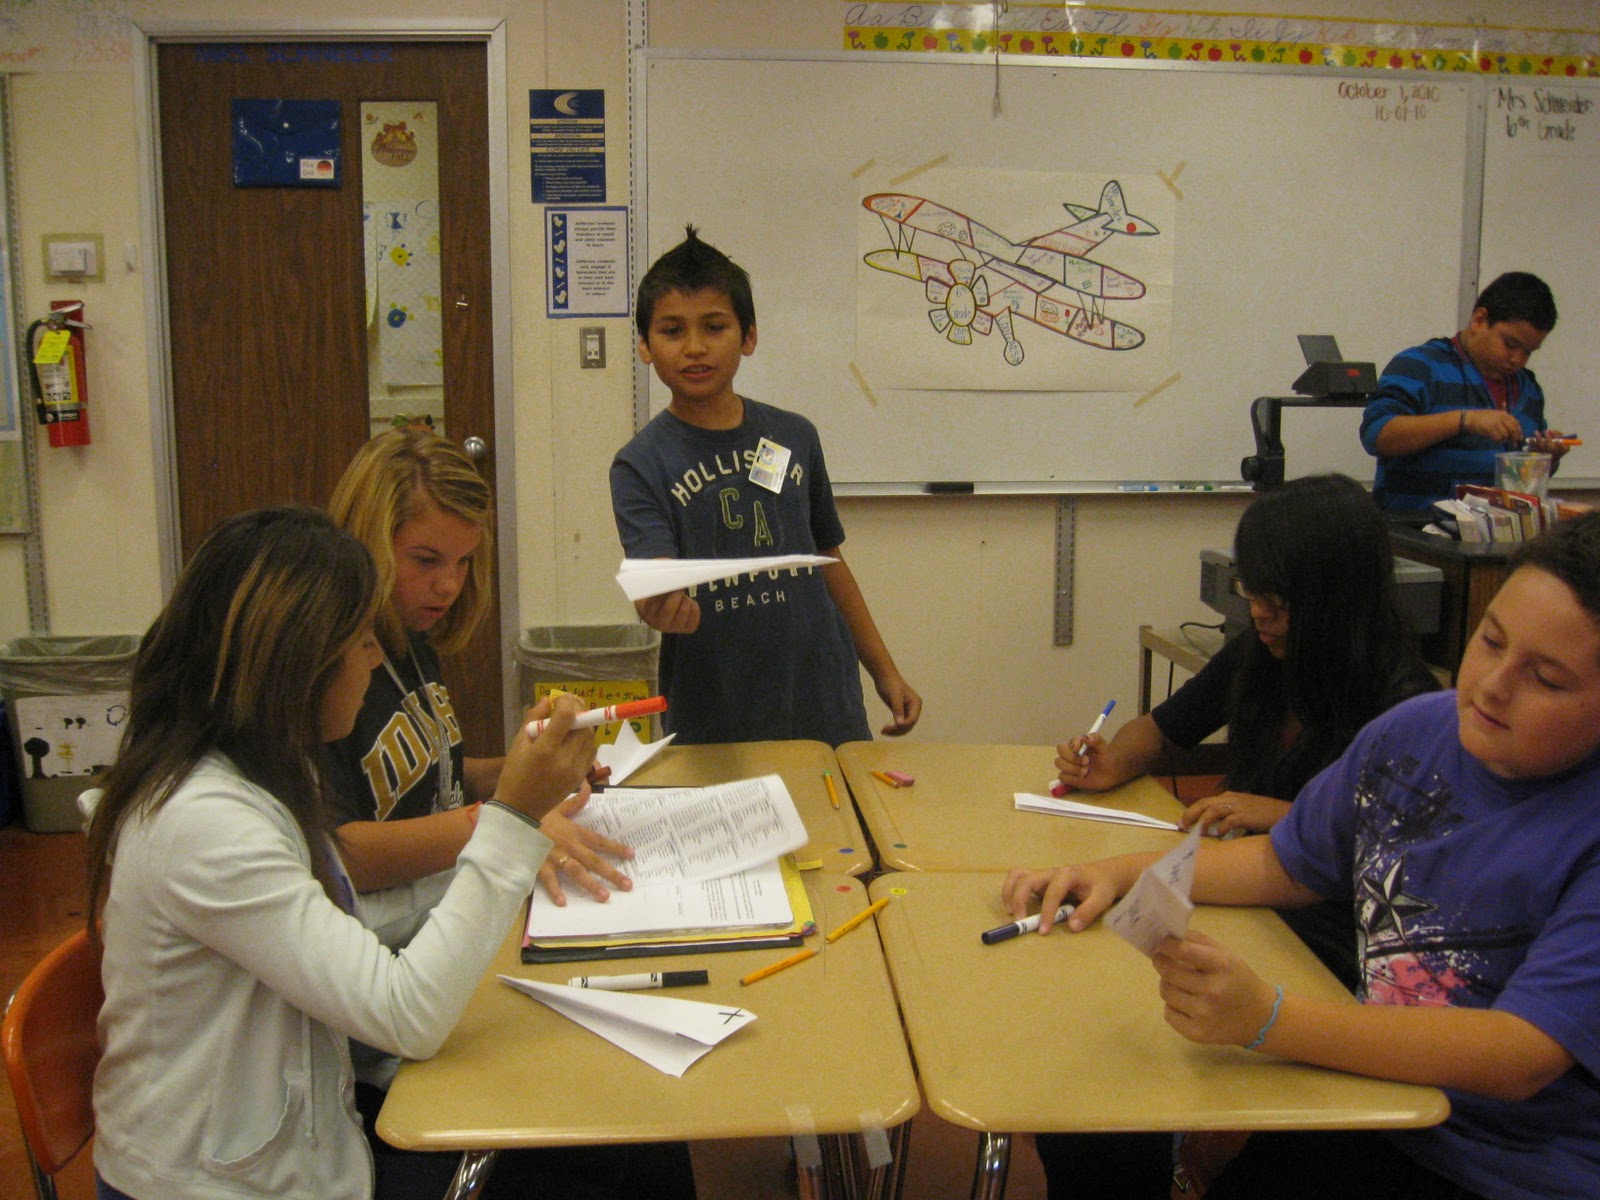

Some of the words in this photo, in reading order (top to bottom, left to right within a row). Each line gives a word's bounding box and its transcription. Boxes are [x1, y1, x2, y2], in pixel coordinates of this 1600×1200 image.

[1338, 81, 1391, 100] October
[671, 450, 803, 507] HOLLISR
[715, 590, 786, 612] BEACH
